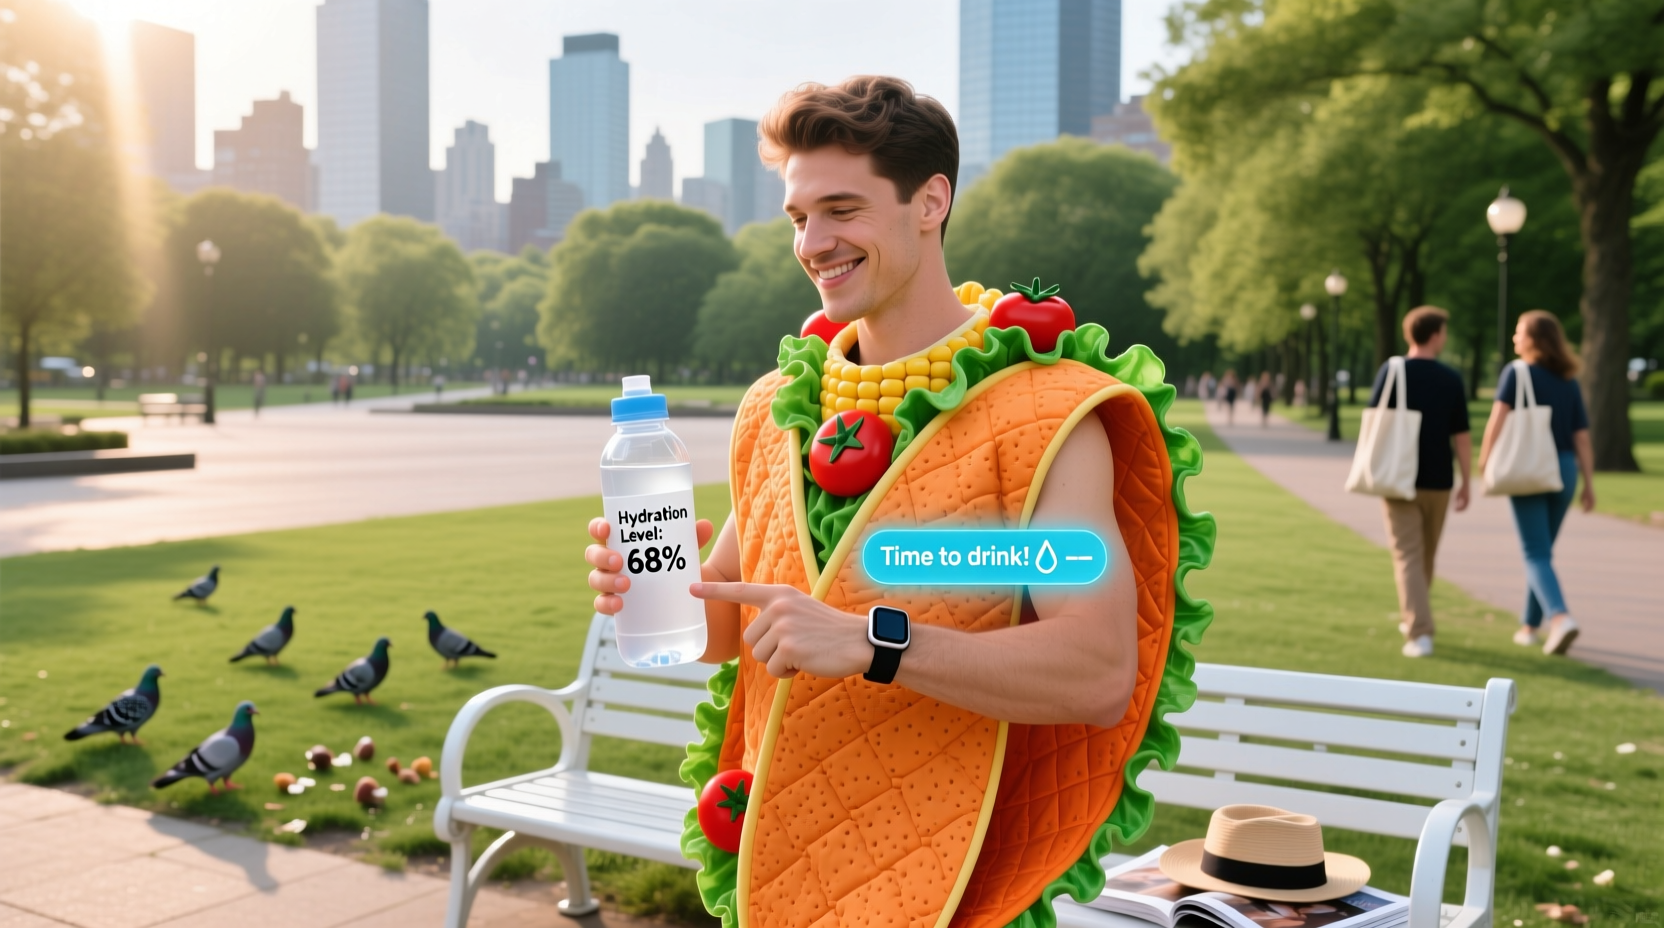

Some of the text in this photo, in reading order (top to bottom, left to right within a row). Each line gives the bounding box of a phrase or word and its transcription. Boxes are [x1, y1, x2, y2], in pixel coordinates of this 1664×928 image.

[618, 505, 688, 528] Hydration
[620, 526, 663, 543] Level:
[627, 544, 687, 574] 68%
